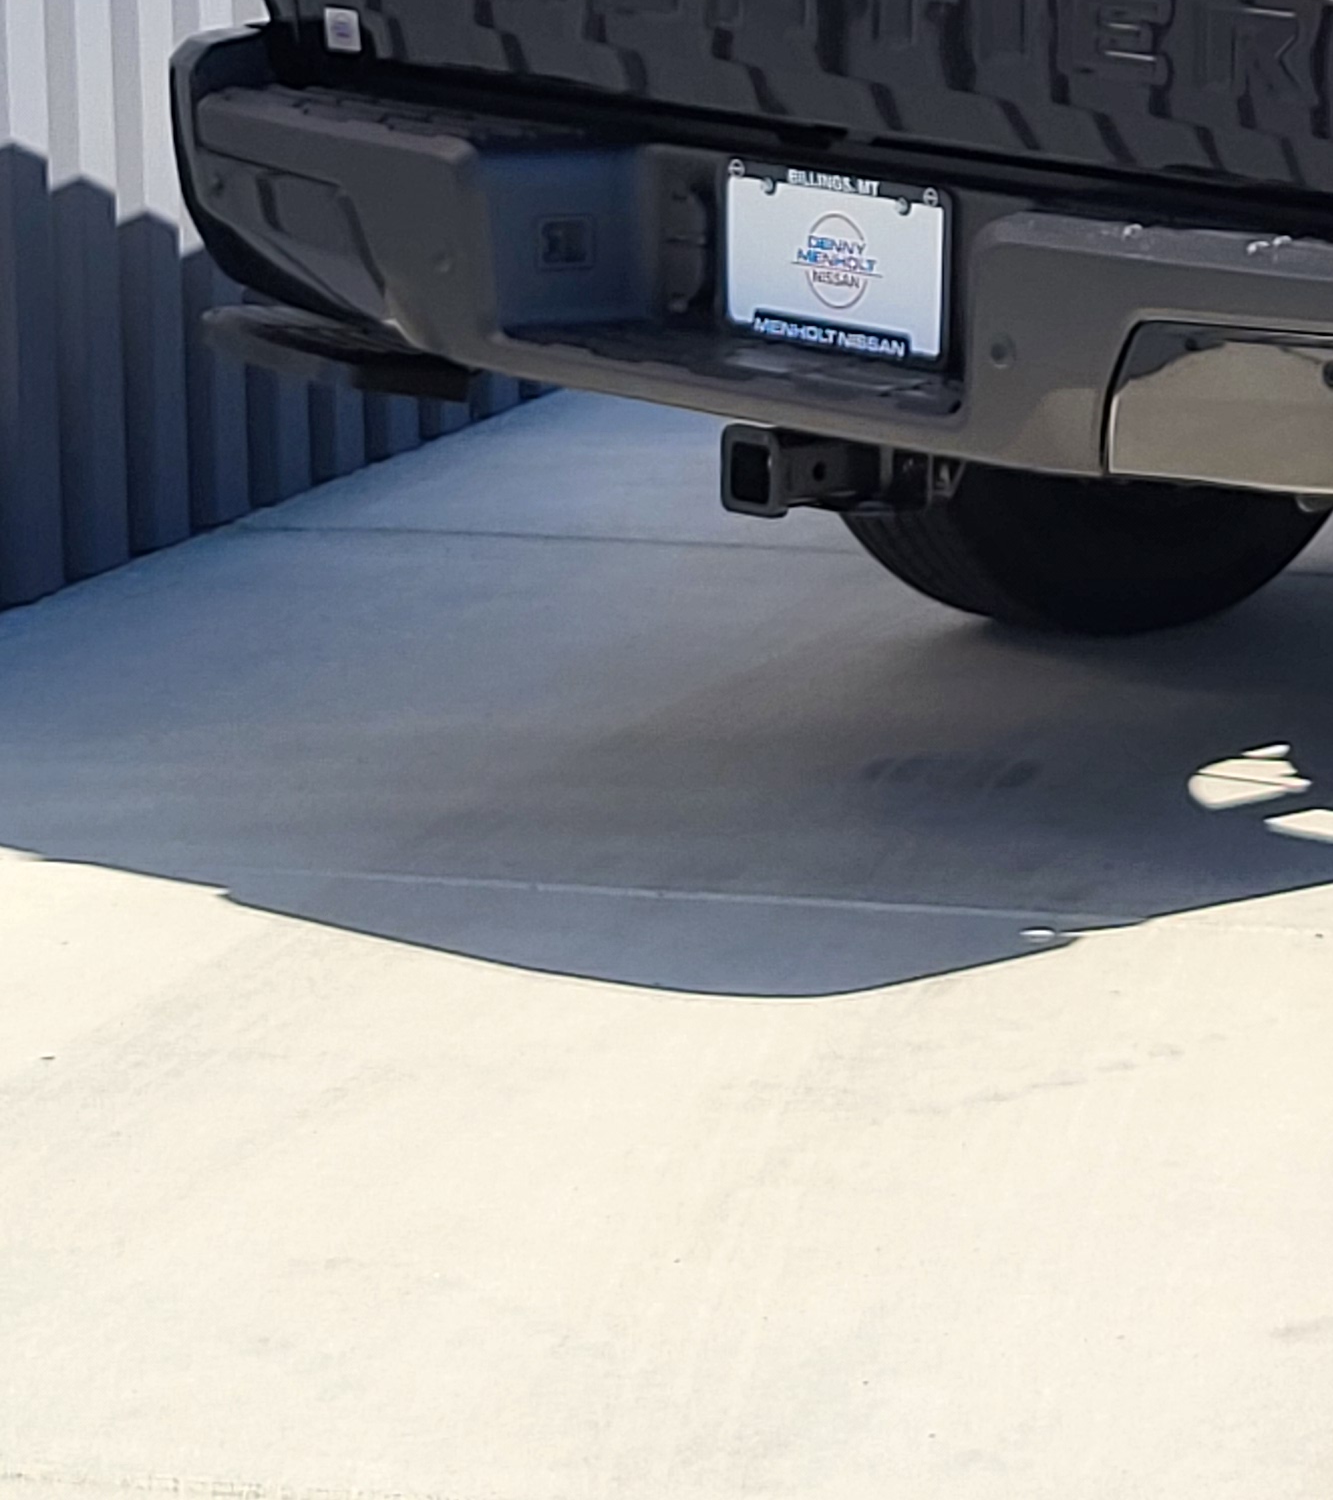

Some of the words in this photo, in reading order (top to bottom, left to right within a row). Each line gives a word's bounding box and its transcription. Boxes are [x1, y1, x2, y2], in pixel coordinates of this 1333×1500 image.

[857, 179, 879, 197] MT
[807, 234, 866, 255] DENNY
[797, 248, 876, 272] MENHOLT
[812, 269, 860, 289] NISSAN
[753, 317, 837, 345] MENHOLT
[838, 332, 905, 357] NISSAN
